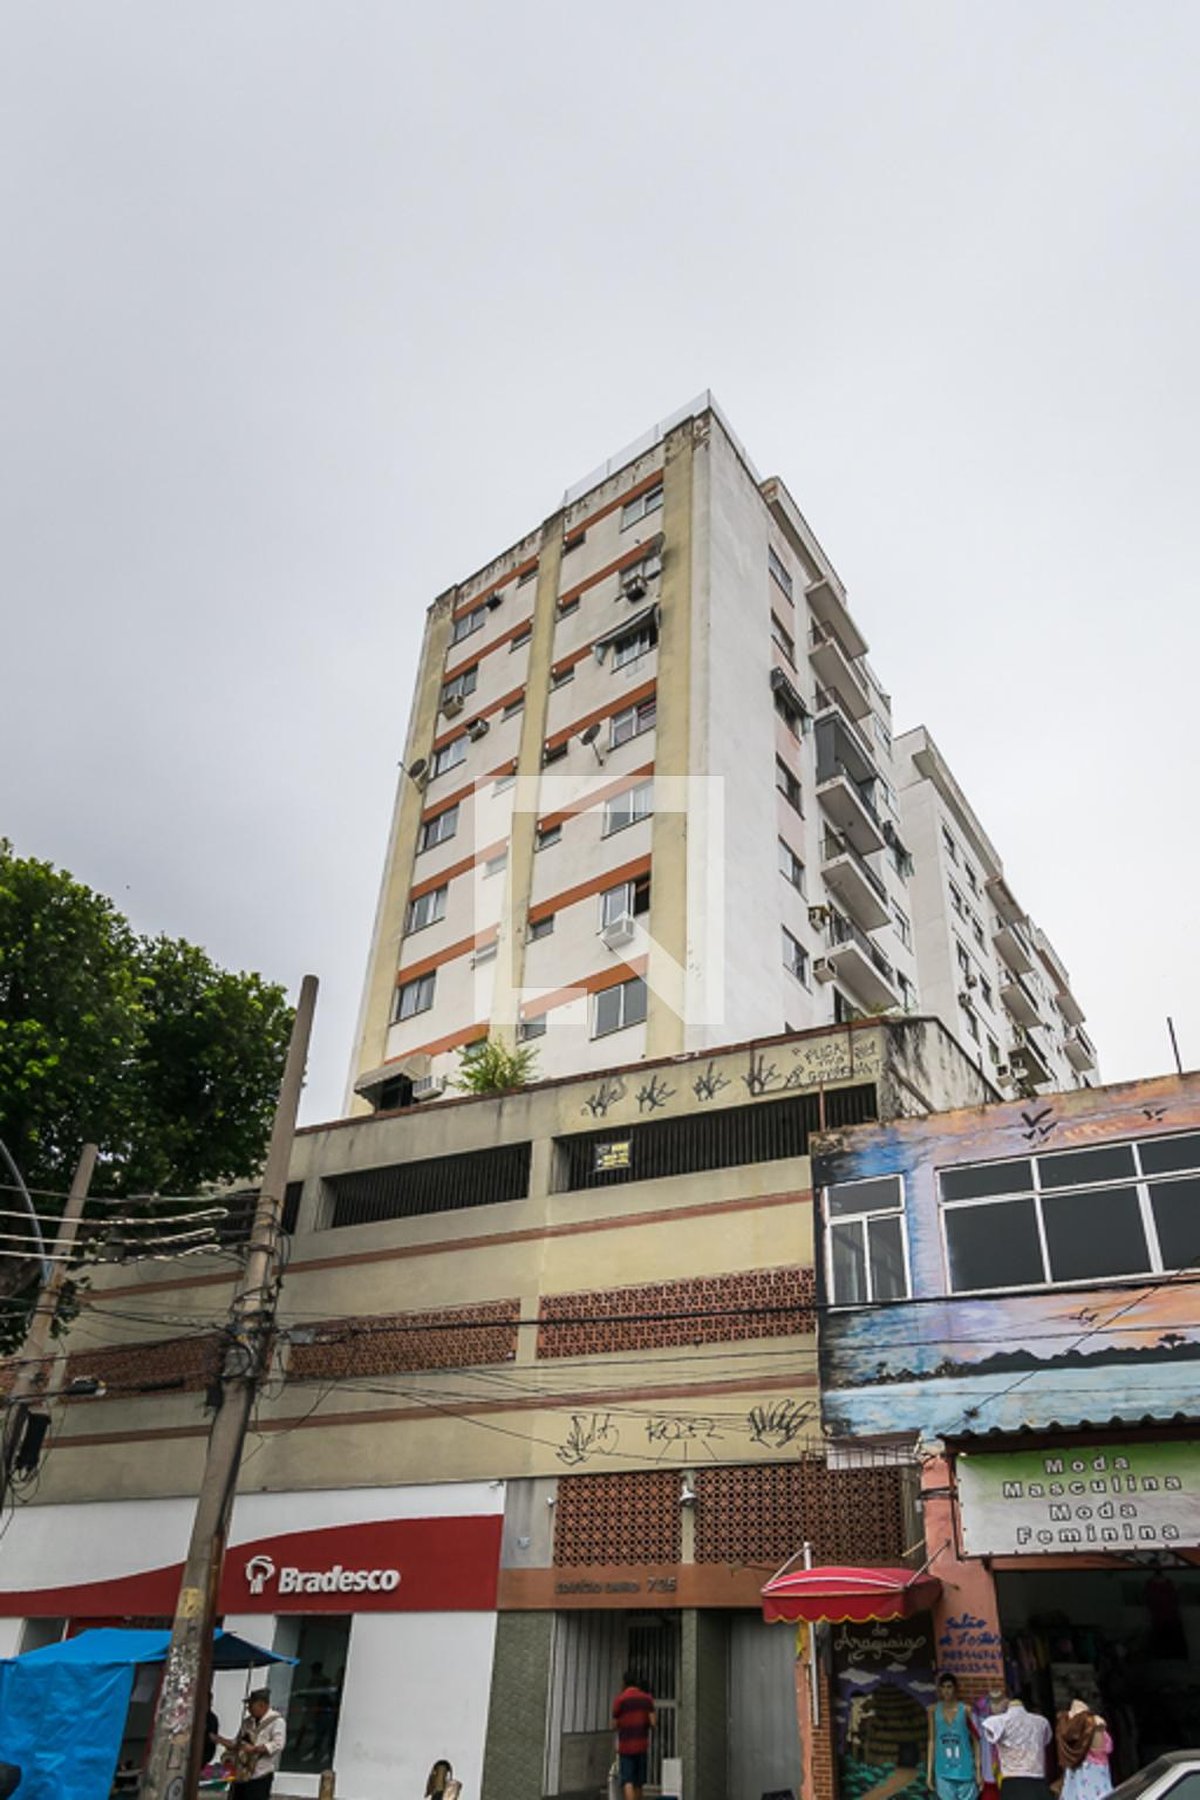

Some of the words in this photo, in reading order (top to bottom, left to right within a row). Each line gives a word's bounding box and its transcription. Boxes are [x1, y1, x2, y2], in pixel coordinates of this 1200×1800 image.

[1044, 1456, 1130, 1474] Moda
[1003, 1475, 1181, 1498] Masculina
[1049, 1501, 1137, 1521] Moda
[1017, 1523, 1180, 1545] Feminina
[278, 1565, 401, 1593] Bradesco
